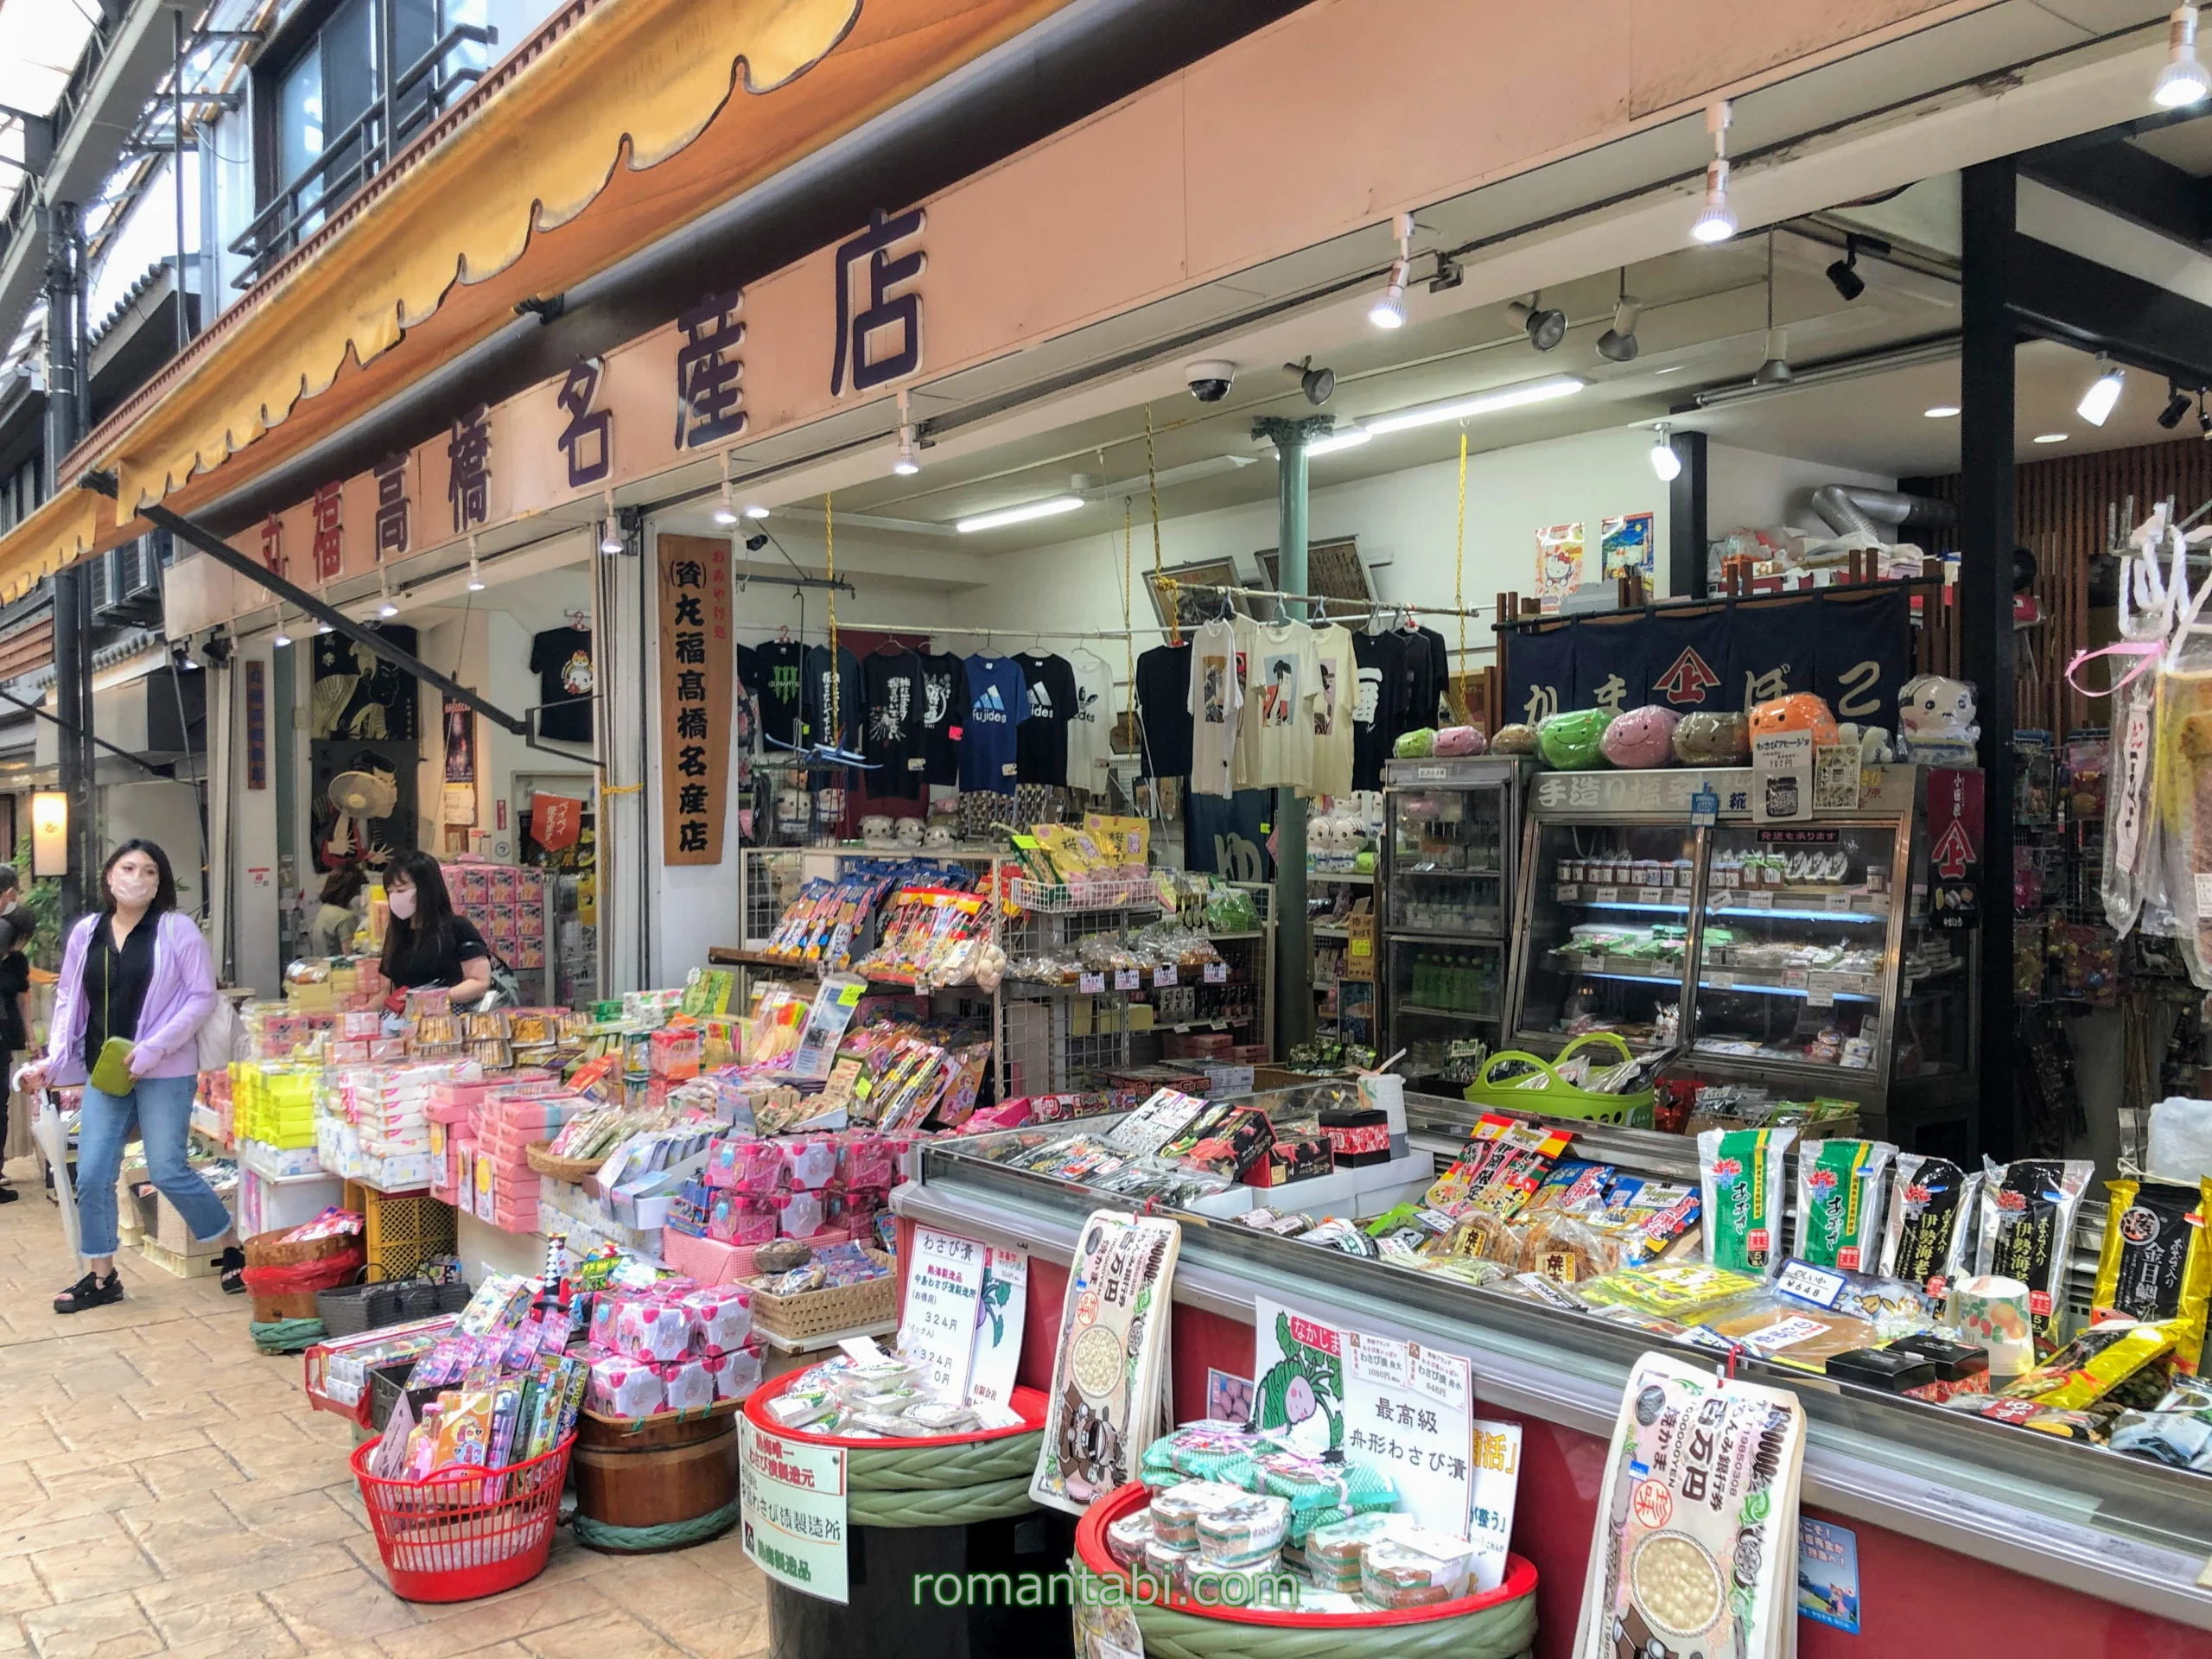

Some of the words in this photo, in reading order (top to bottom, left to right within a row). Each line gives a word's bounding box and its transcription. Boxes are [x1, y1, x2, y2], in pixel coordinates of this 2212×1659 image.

[923, 1233, 974, 1262] わさび漬
[1375, 1396, 1439, 1435] 最高級
[1349, 1427, 1467, 1482] 舟形わさび漬
